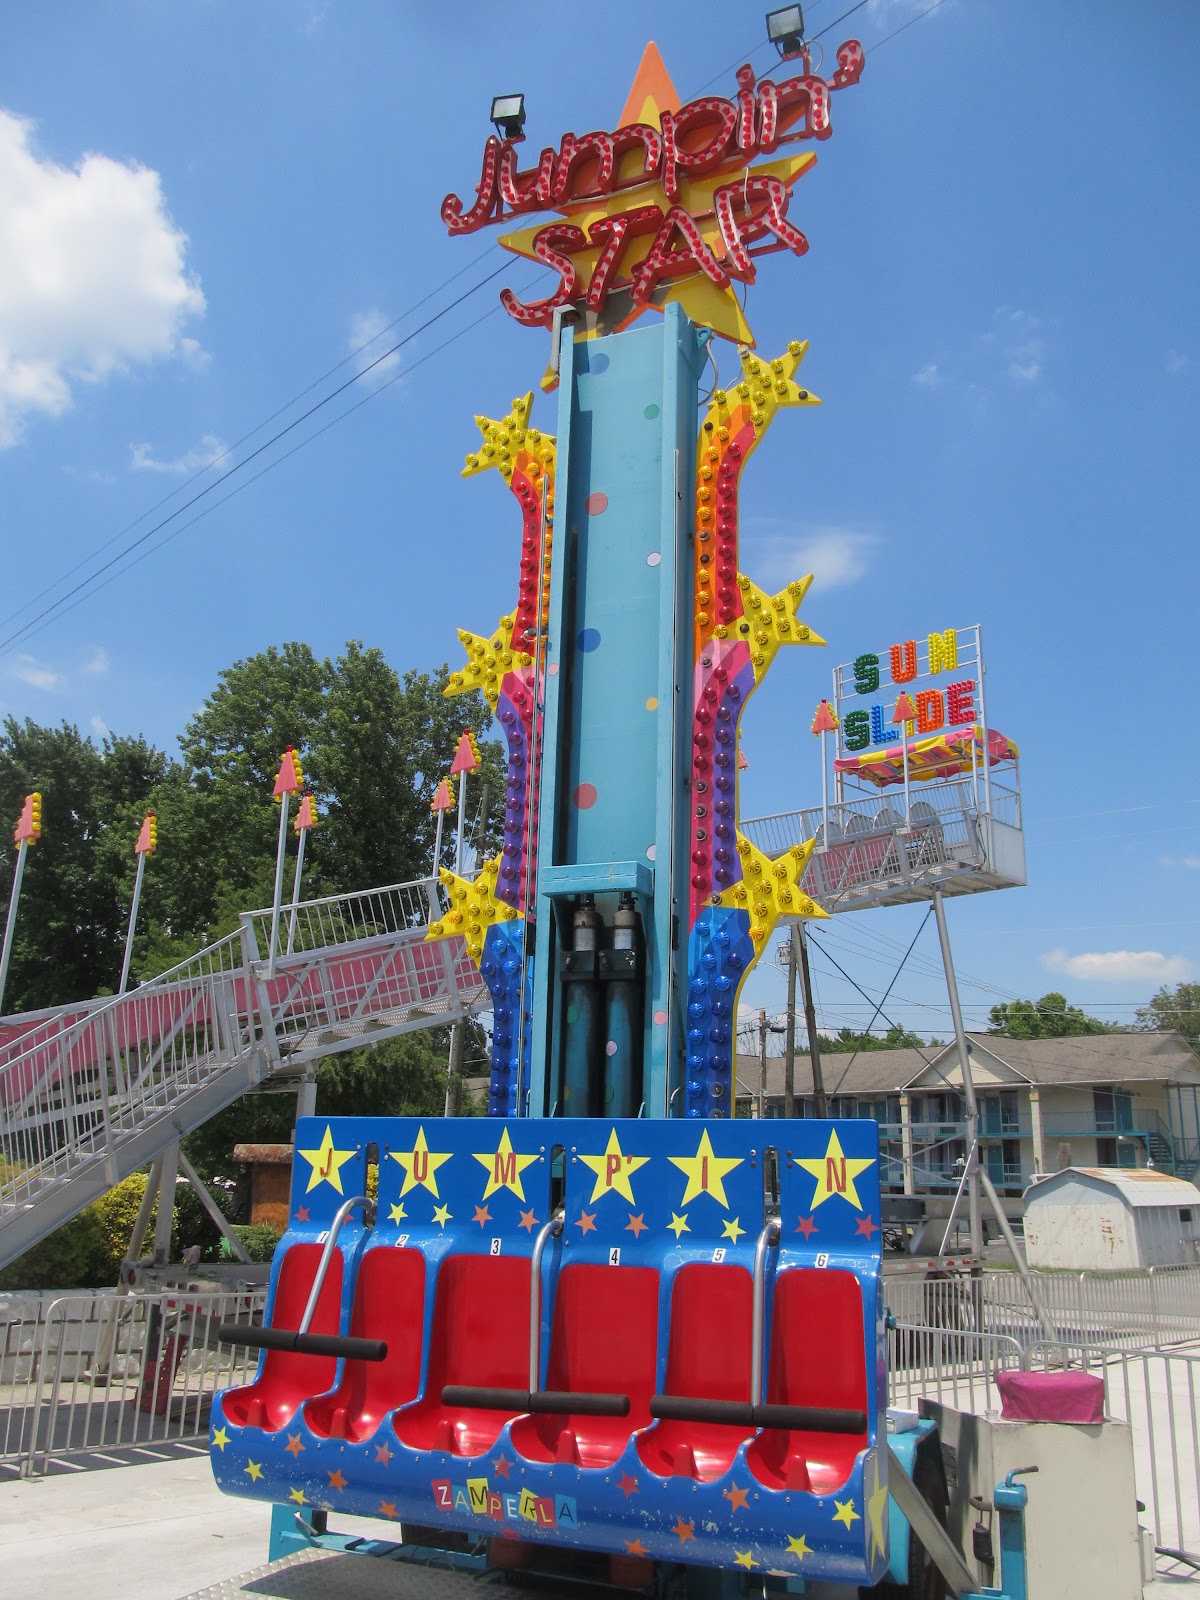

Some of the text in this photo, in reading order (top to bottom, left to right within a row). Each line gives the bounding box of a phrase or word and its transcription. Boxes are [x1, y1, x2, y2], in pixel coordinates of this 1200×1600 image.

[500, 175, 810, 327] STAR
[853, 628, 958, 695] SUN
[611, 1250, 619, 1264] 4
[714, 1249, 724, 1262] 5
[817, 1254, 826, 1267] 6
[437, 1485, 574, 1523] ZAMPERLA
